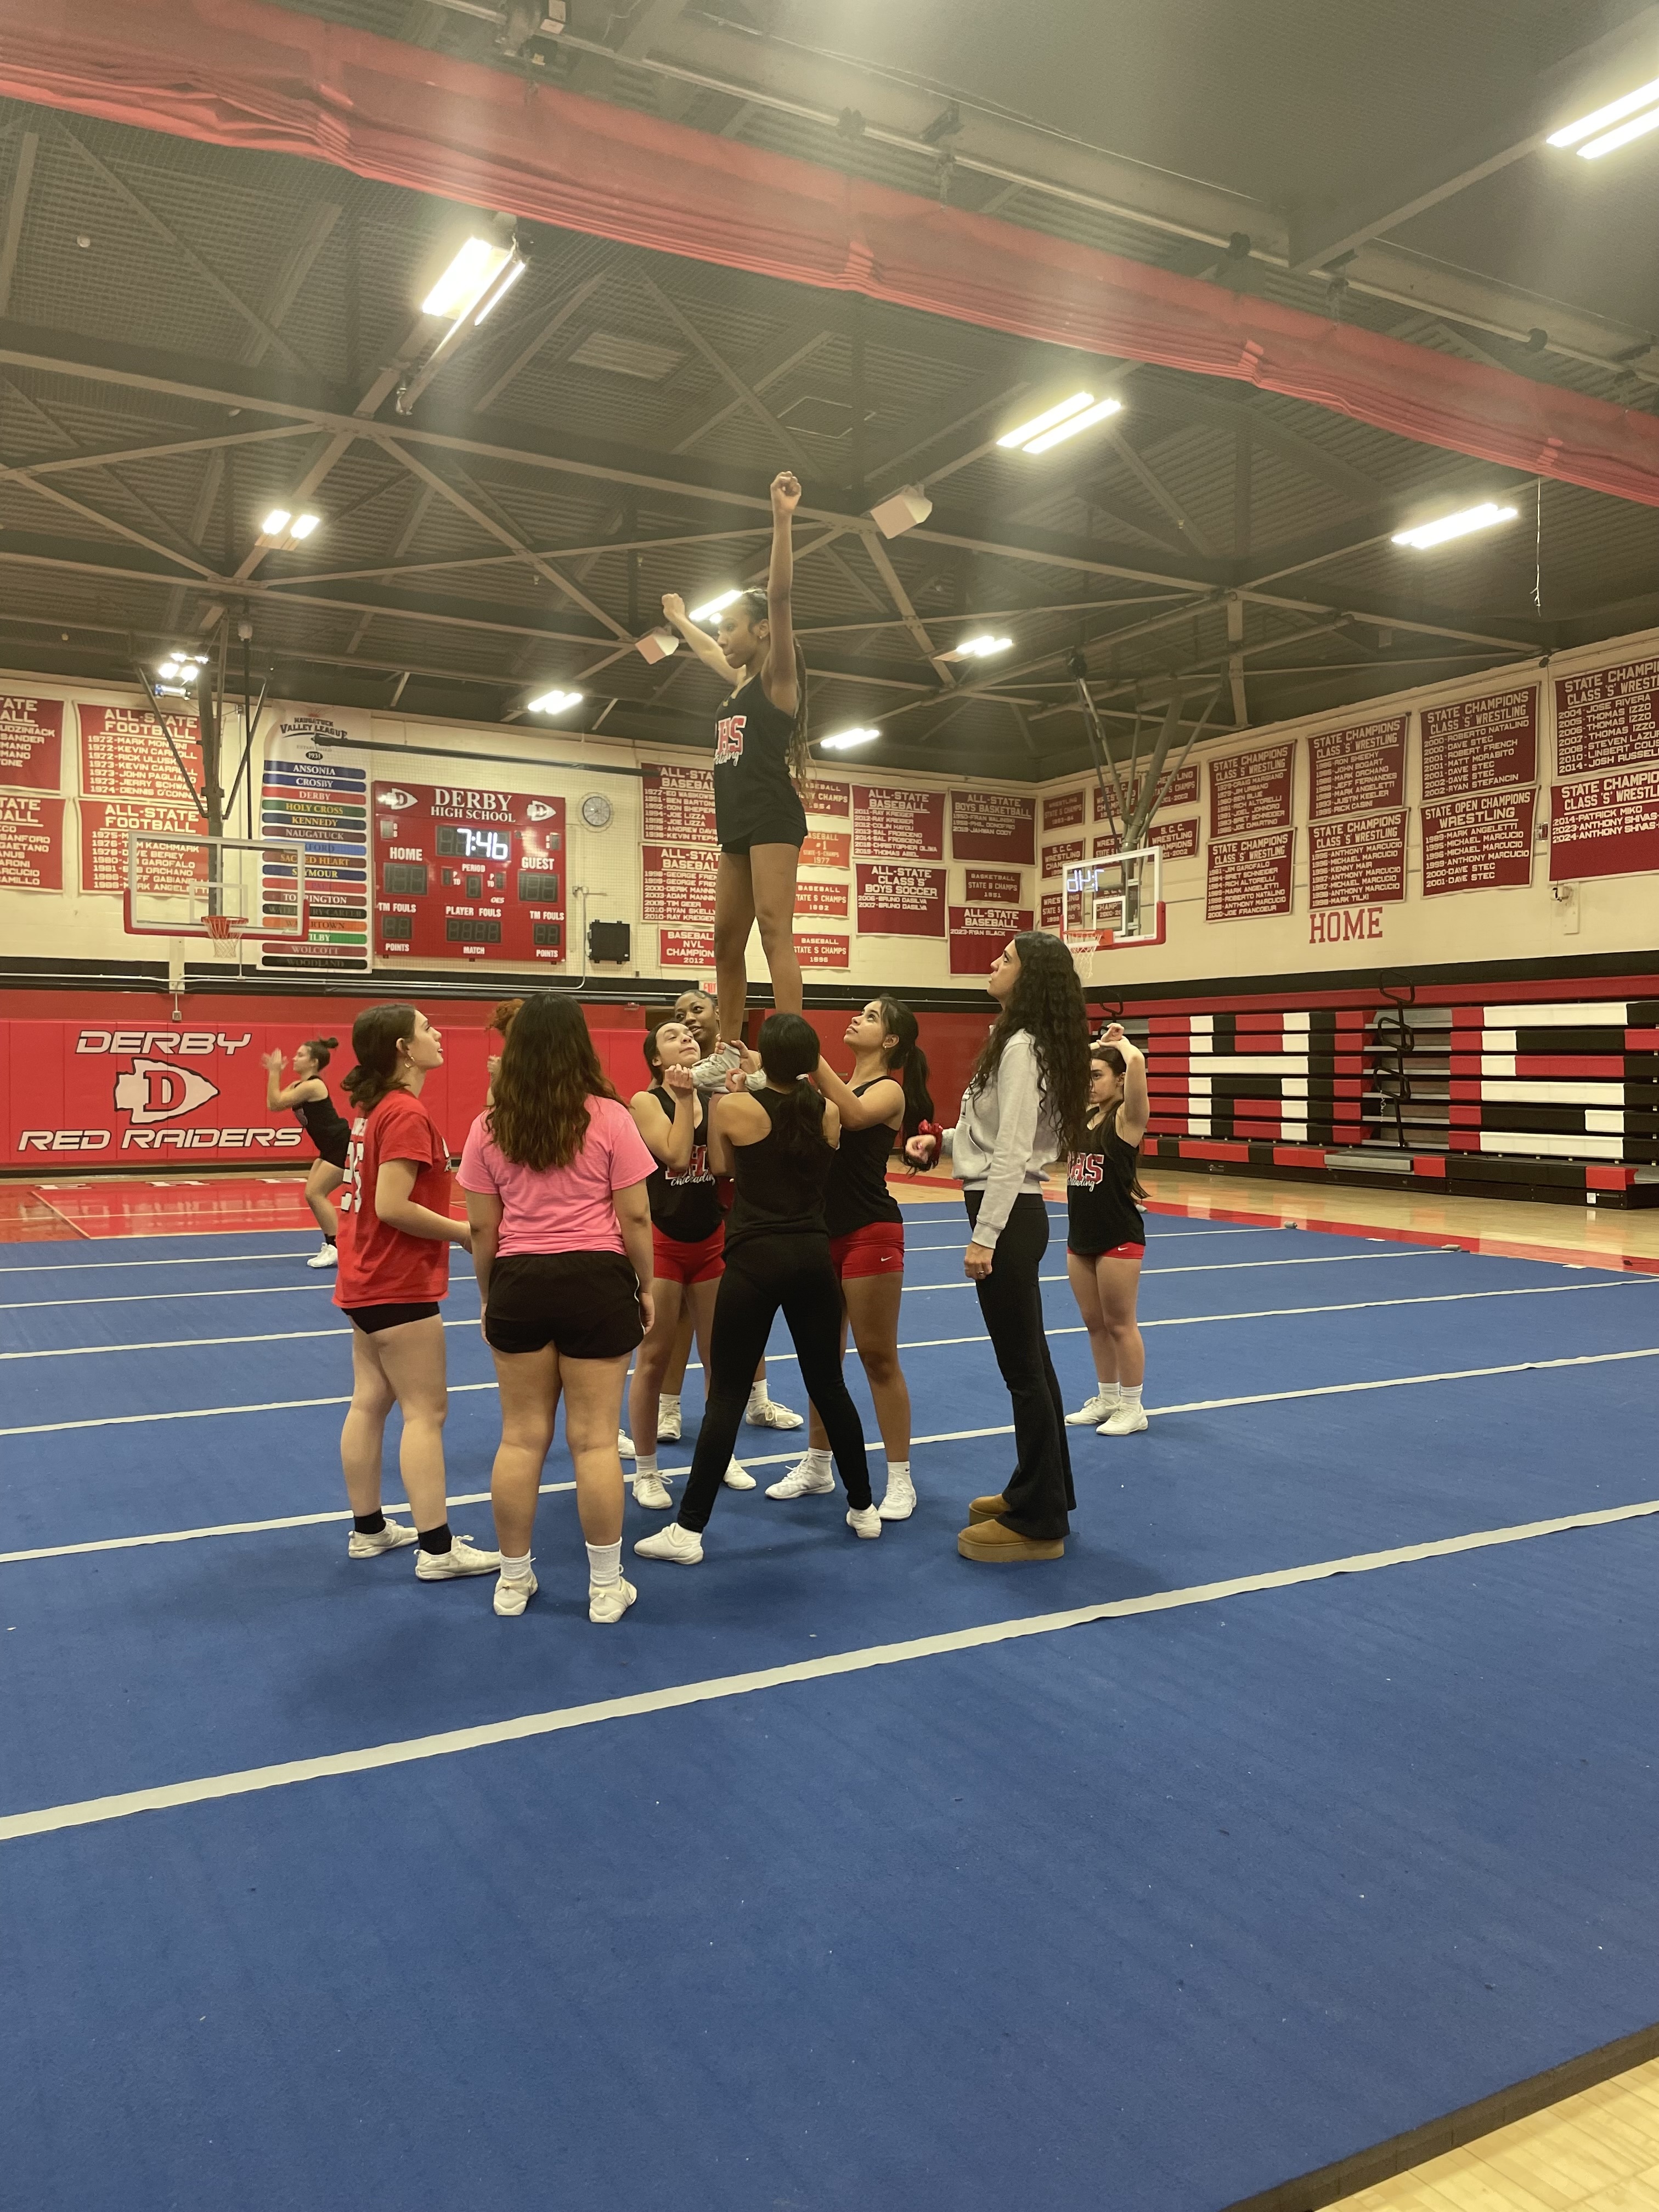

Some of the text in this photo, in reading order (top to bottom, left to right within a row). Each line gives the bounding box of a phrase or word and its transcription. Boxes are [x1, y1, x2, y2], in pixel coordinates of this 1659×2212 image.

[1565, 674, 1602, 693] STATE
[1567, 688, 1601, 706] CLASS
[1615, 694, 1651, 707] RIVERA
[1427, 691, 1528, 723] STATE CHAMPIONS
[1629, 703, 1651, 714] IZZO
[1431, 719, 1459, 735] CLASS
[1476, 705, 1526, 725] WRESTLING
[1629, 713, 1651, 723] IZZO
[280, 724, 347, 738] VALLEY LEAGUE
[1633, 721, 1655, 732] IZZO
[1483, 739, 1517, 752] FRENCH
[1472, 748, 1514, 763] MORABITO
[293, 765, 335, 775] ANSONIA
[1472, 761, 1494, 771] STEC
[1472, 770, 1494, 780] STEC
[1472, 774, 1519, 788] STEFANCIN
[296, 777, 334, 788] CROSBY
[299, 791, 331, 800] DERBY
[868, 789, 929, 802] ALL-STATE
[1561, 781, 1599, 798] STATE
[434, 788, 513, 811] DERBY
[870, 799, 928, 811] BASEBALL
[967, 794, 1021, 807] ALL-STATE
[1565, 794, 1598, 811] CLASS
[286, 803, 343, 814] HOLY CROSS
[955, 802, 1031, 817] BOYS BASKETBALL
[1425, 792, 1531, 820] STATE OPEN CHAMPIONS
[1620, 805, 1643, 816] MIKO
[105, 804, 199, 822] ALL-STATE
[431, 806, 516, 822] HIGH SCHOOL
[1440, 807, 1515, 828] WRESTLING
[106, 816, 196, 833] FOOTBALL
[292, 816, 338, 827] KENNEDY
[286, 829, 344, 839] NAUGATUCK
[1471, 823, 1517, 835] ANGELETTI
[1483, 831, 1523, 842] MARCUCIO
[146, 842, 199, 853] KACHMARK
[456, 828, 508, 860] 7:46
[1483, 841, 1523, 851] MARCUCIO
[390, 847, 422, 861] HOME
[1488, 850, 1529, 860] MARCUCIO
[280, 855, 350, 866] SACED HEART
[521, 857, 555, 870] GUEST
[462, 864, 486, 872] PERIOD
[871, 866, 932, 878] ALL-STATE
[1472, 862, 1495, 872] STEC
[878, 876, 915, 885] CLASS
[1471, 872, 1495, 881] STEC
[865, 884, 937, 896] BOYS SOCCER
[283, 894, 347, 904] TORINGTON
[379, 902, 416, 913] TM FOULS
[446, 906, 501, 917] PLAYER FOULS
[529, 911, 565, 921] TM FOULS
[964, 909, 1019, 919] ALL-STATE
[965, 918, 1018, 928] BASEBALL
[1310, 907, 1383, 944] HOME
[291, 946, 339, 955] WOLCOTT
[75, 1030, 251, 1055] DERBY
[18, 1127, 303, 1151] RED RAIDERS
